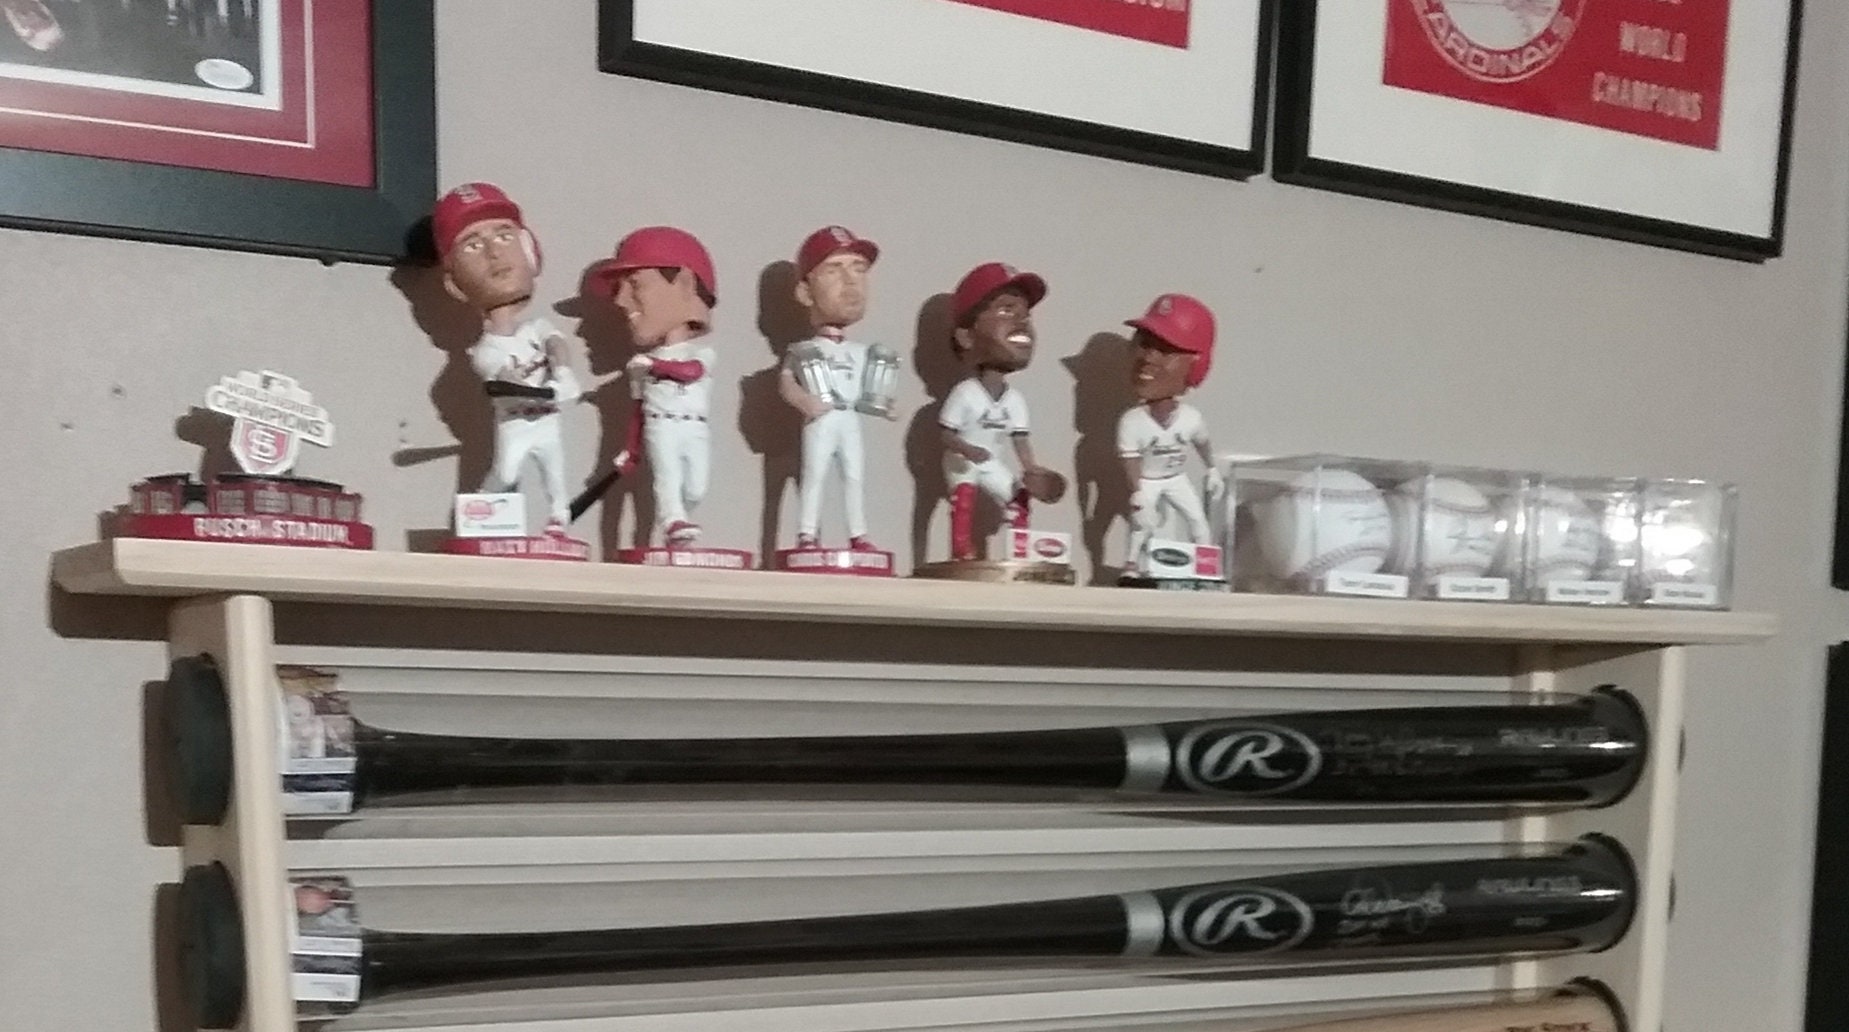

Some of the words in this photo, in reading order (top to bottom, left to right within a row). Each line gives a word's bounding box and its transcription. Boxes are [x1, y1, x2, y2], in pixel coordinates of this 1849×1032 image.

[1619, 20, 1687, 63] WORLD
[1592, 70, 1703, 122] CHAMPIONS
[271, 518, 350, 545] STADIUM
